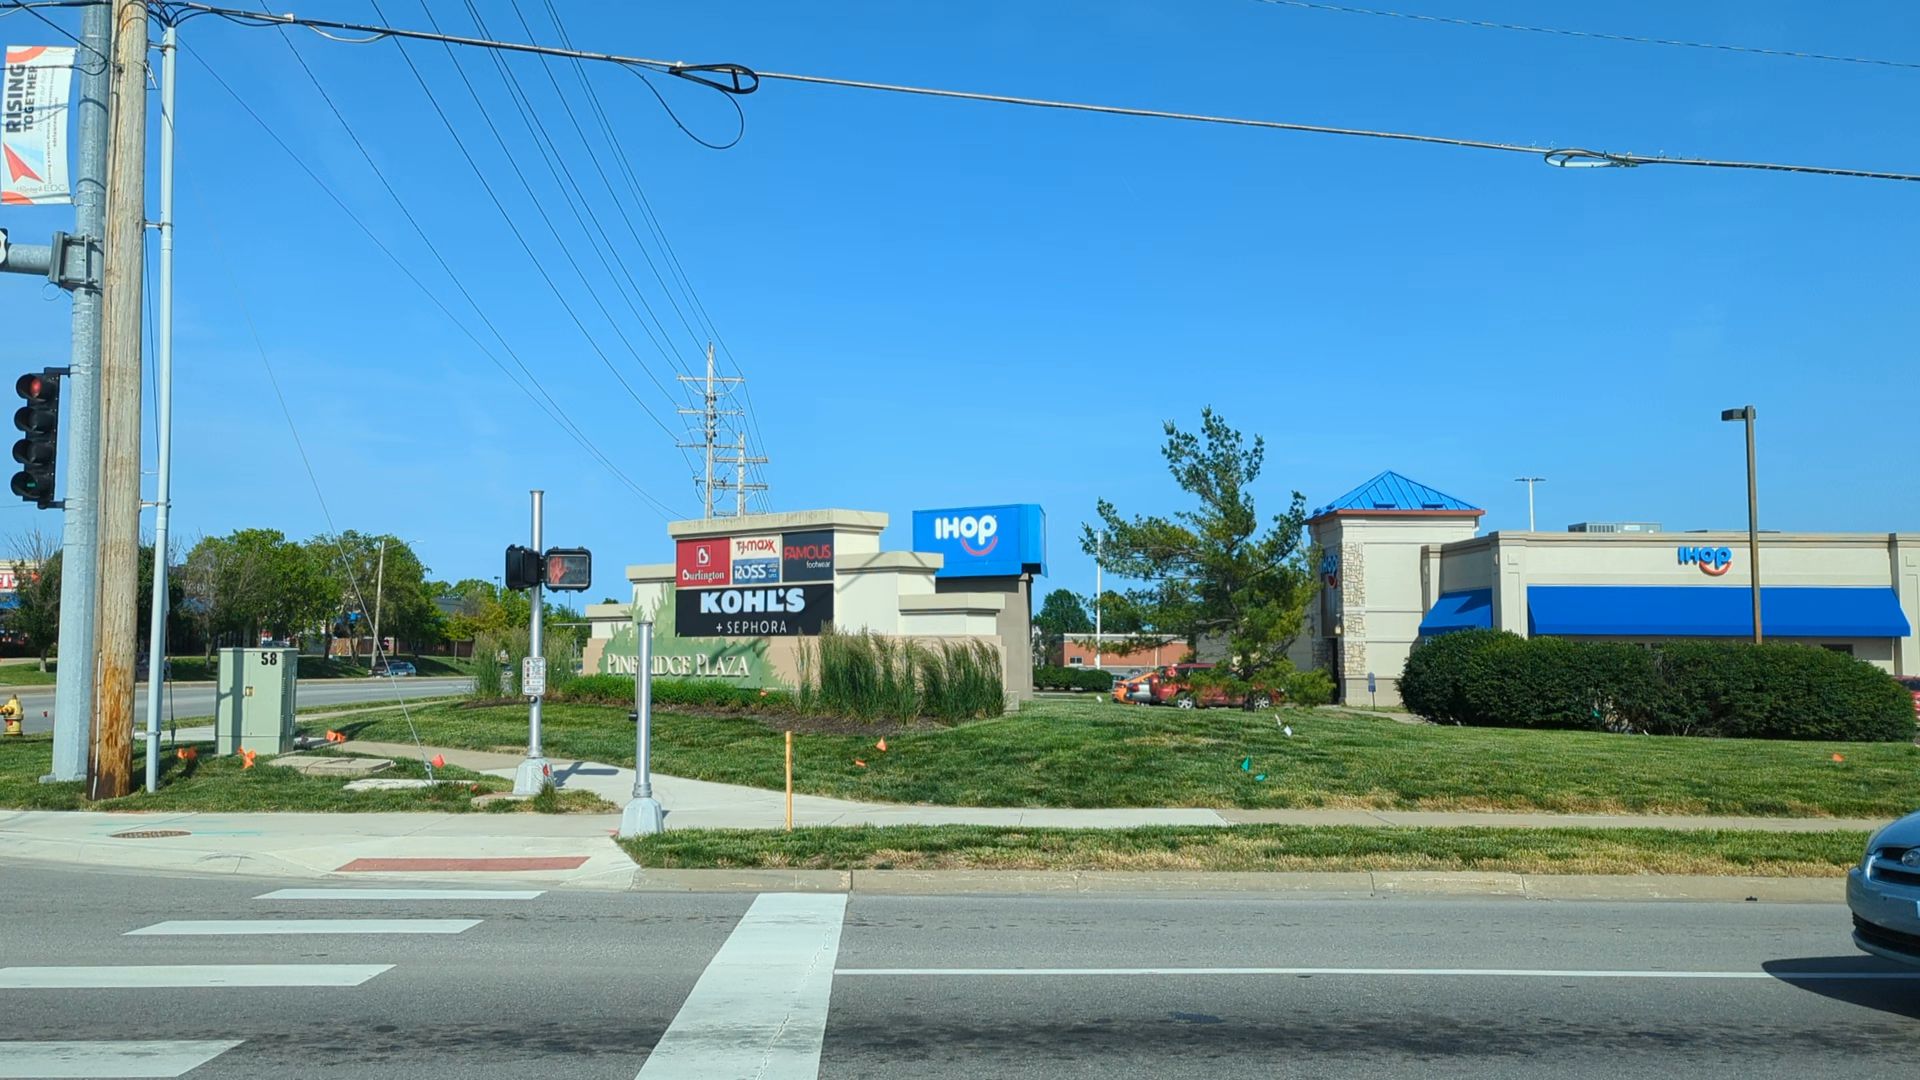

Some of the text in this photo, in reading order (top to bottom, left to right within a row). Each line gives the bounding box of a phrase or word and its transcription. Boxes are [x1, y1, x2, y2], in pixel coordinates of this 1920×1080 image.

[6, 64, 26, 133] RISING
[24, 65, 38, 132] TOGETHER
[784, 544, 831, 561] FAMOUS
[735, 564, 767, 580] ROSS
[806, 560, 831, 569] footwear
[682, 568, 725, 583] Burlington
[700, 588, 806, 614] KOHL'S
[727, 620, 787, 634] SEPHORA
[261, 652, 277, 666] 58
[607, 653, 750, 677] PINEIDGE PLAZA
